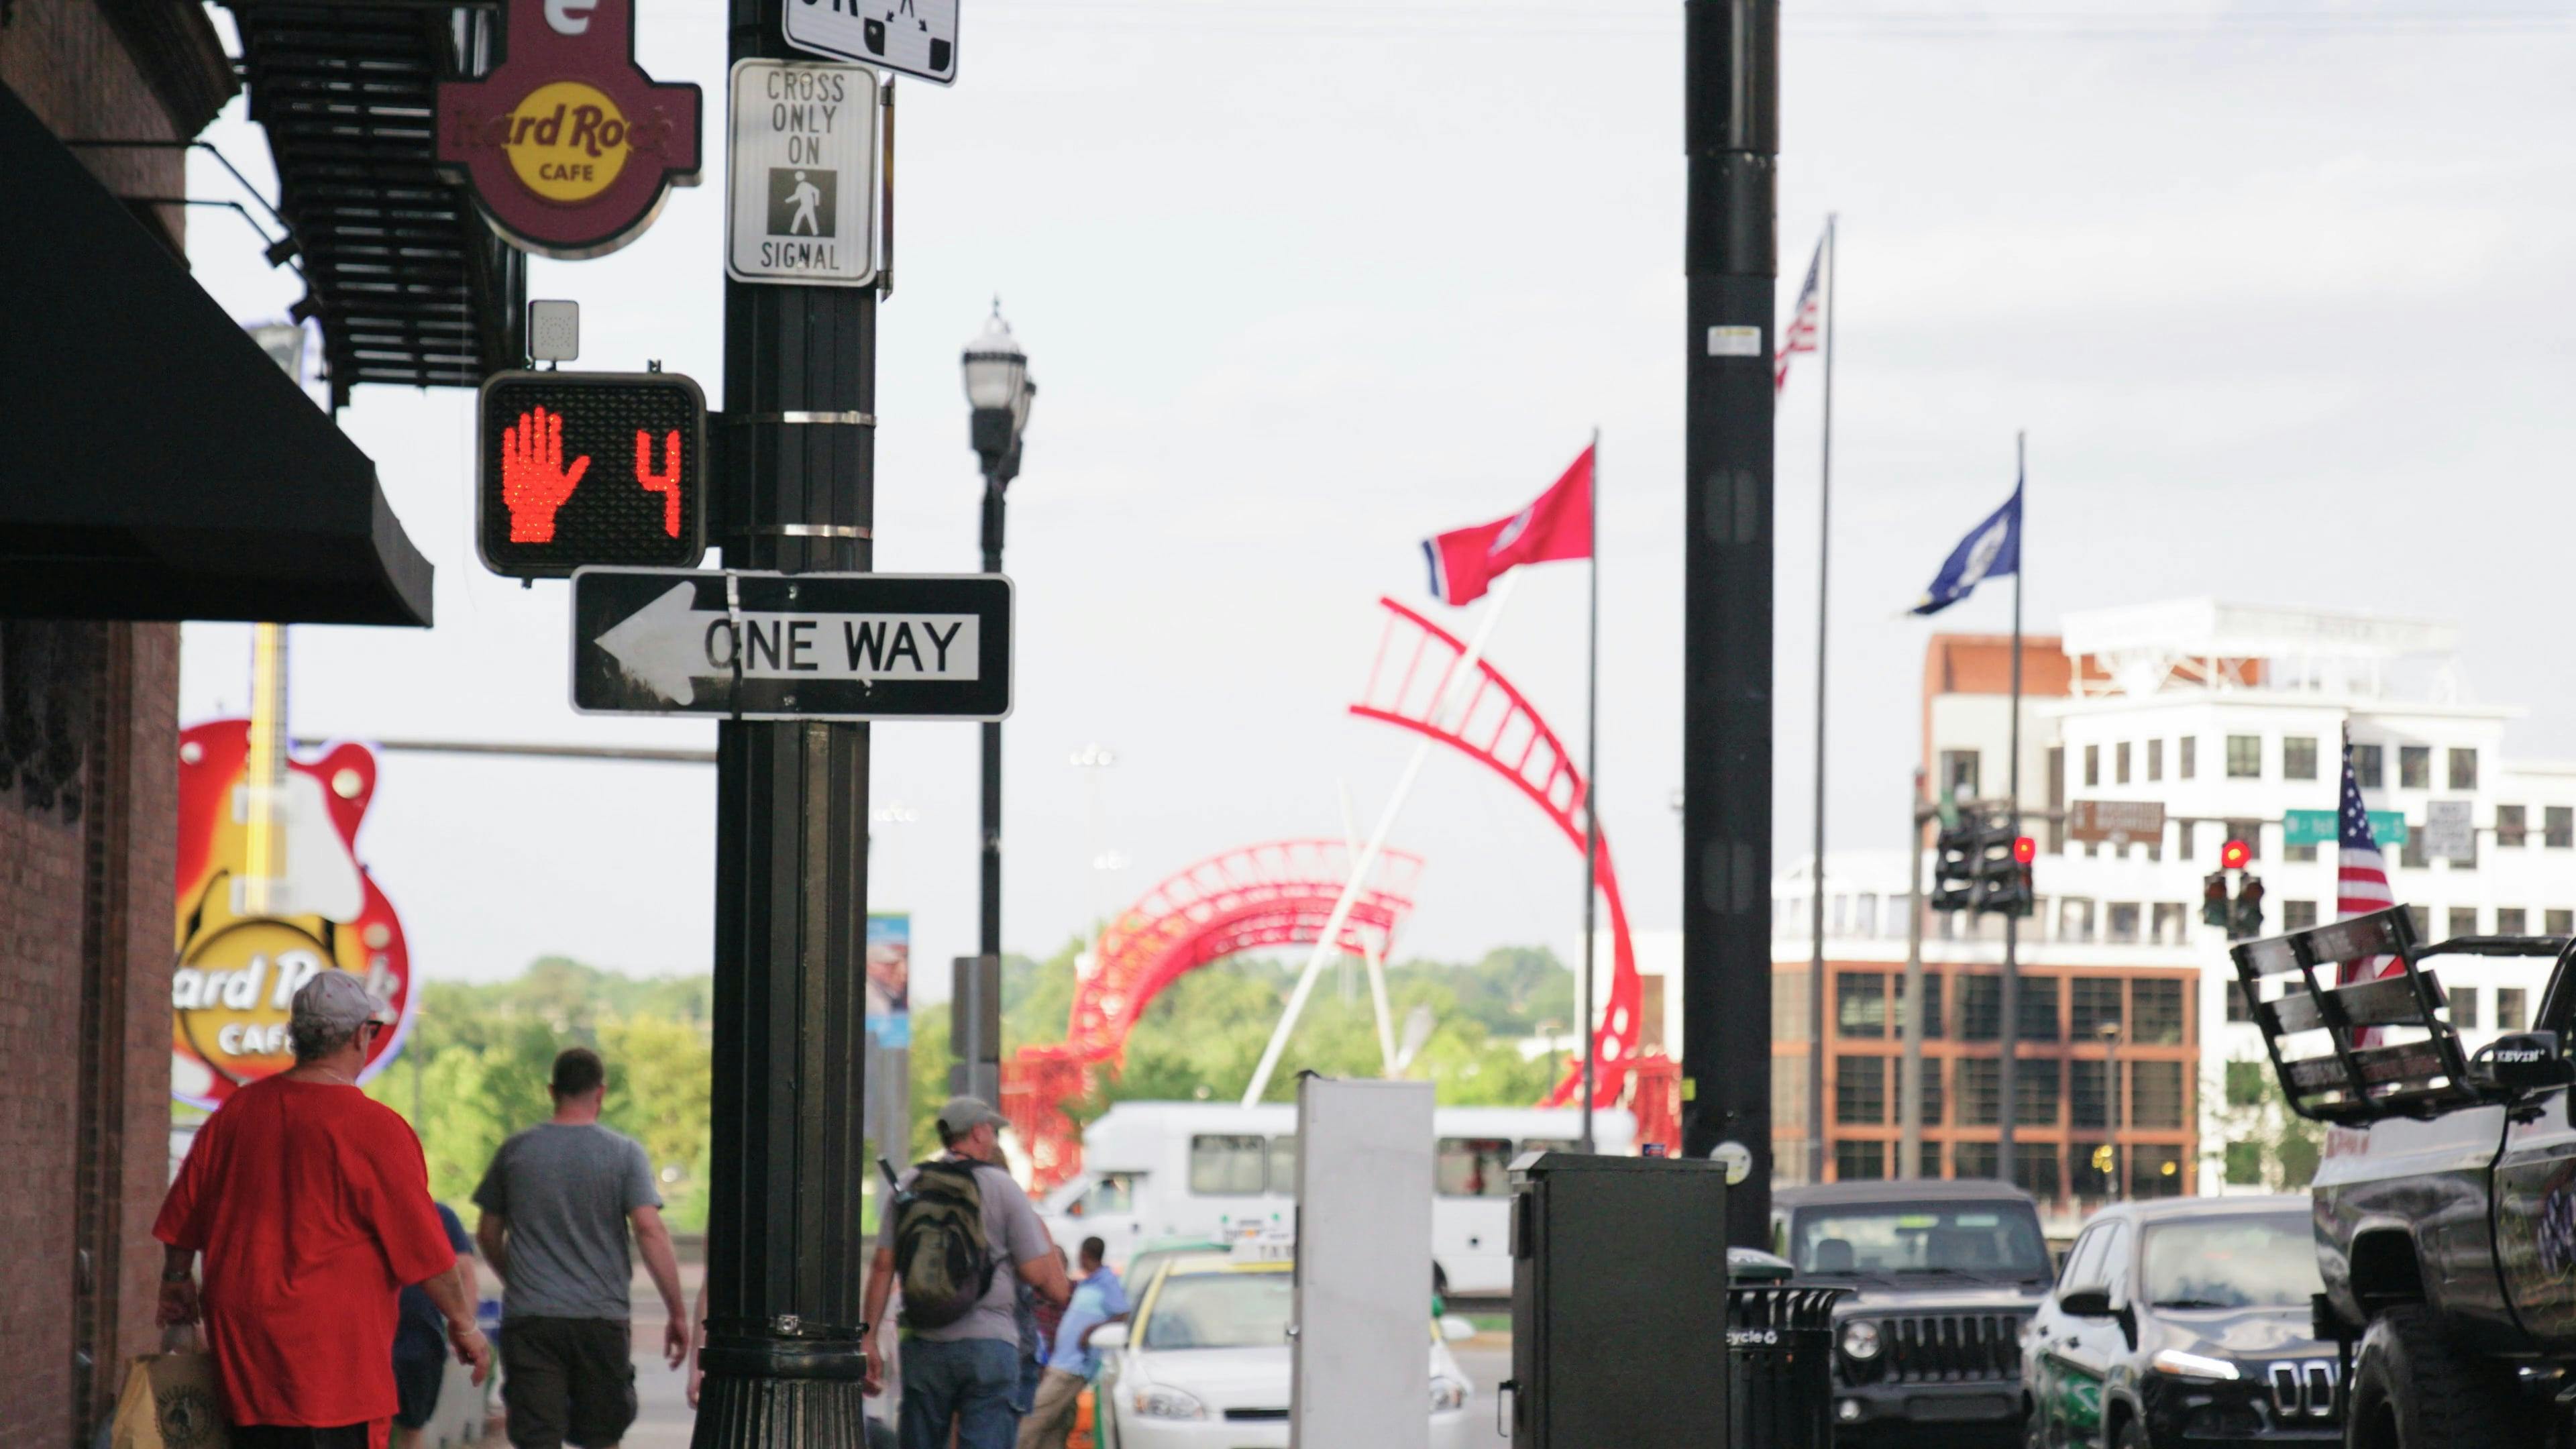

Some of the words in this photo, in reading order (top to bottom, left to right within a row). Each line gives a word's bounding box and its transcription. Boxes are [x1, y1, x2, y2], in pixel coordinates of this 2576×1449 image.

[767, 70, 844, 102] CROSS
[773, 103, 837, 133] ONLY
[788, 136, 820, 164] ON
[539, 163, 594, 181] CAFE
[760, 241, 840, 270] SIGNAL
[635, 429, 681, 539] 4
[705, 619, 818, 670] ONE
[843, 621, 962, 672] WAY
[172, 954, 267, 1008] ard
